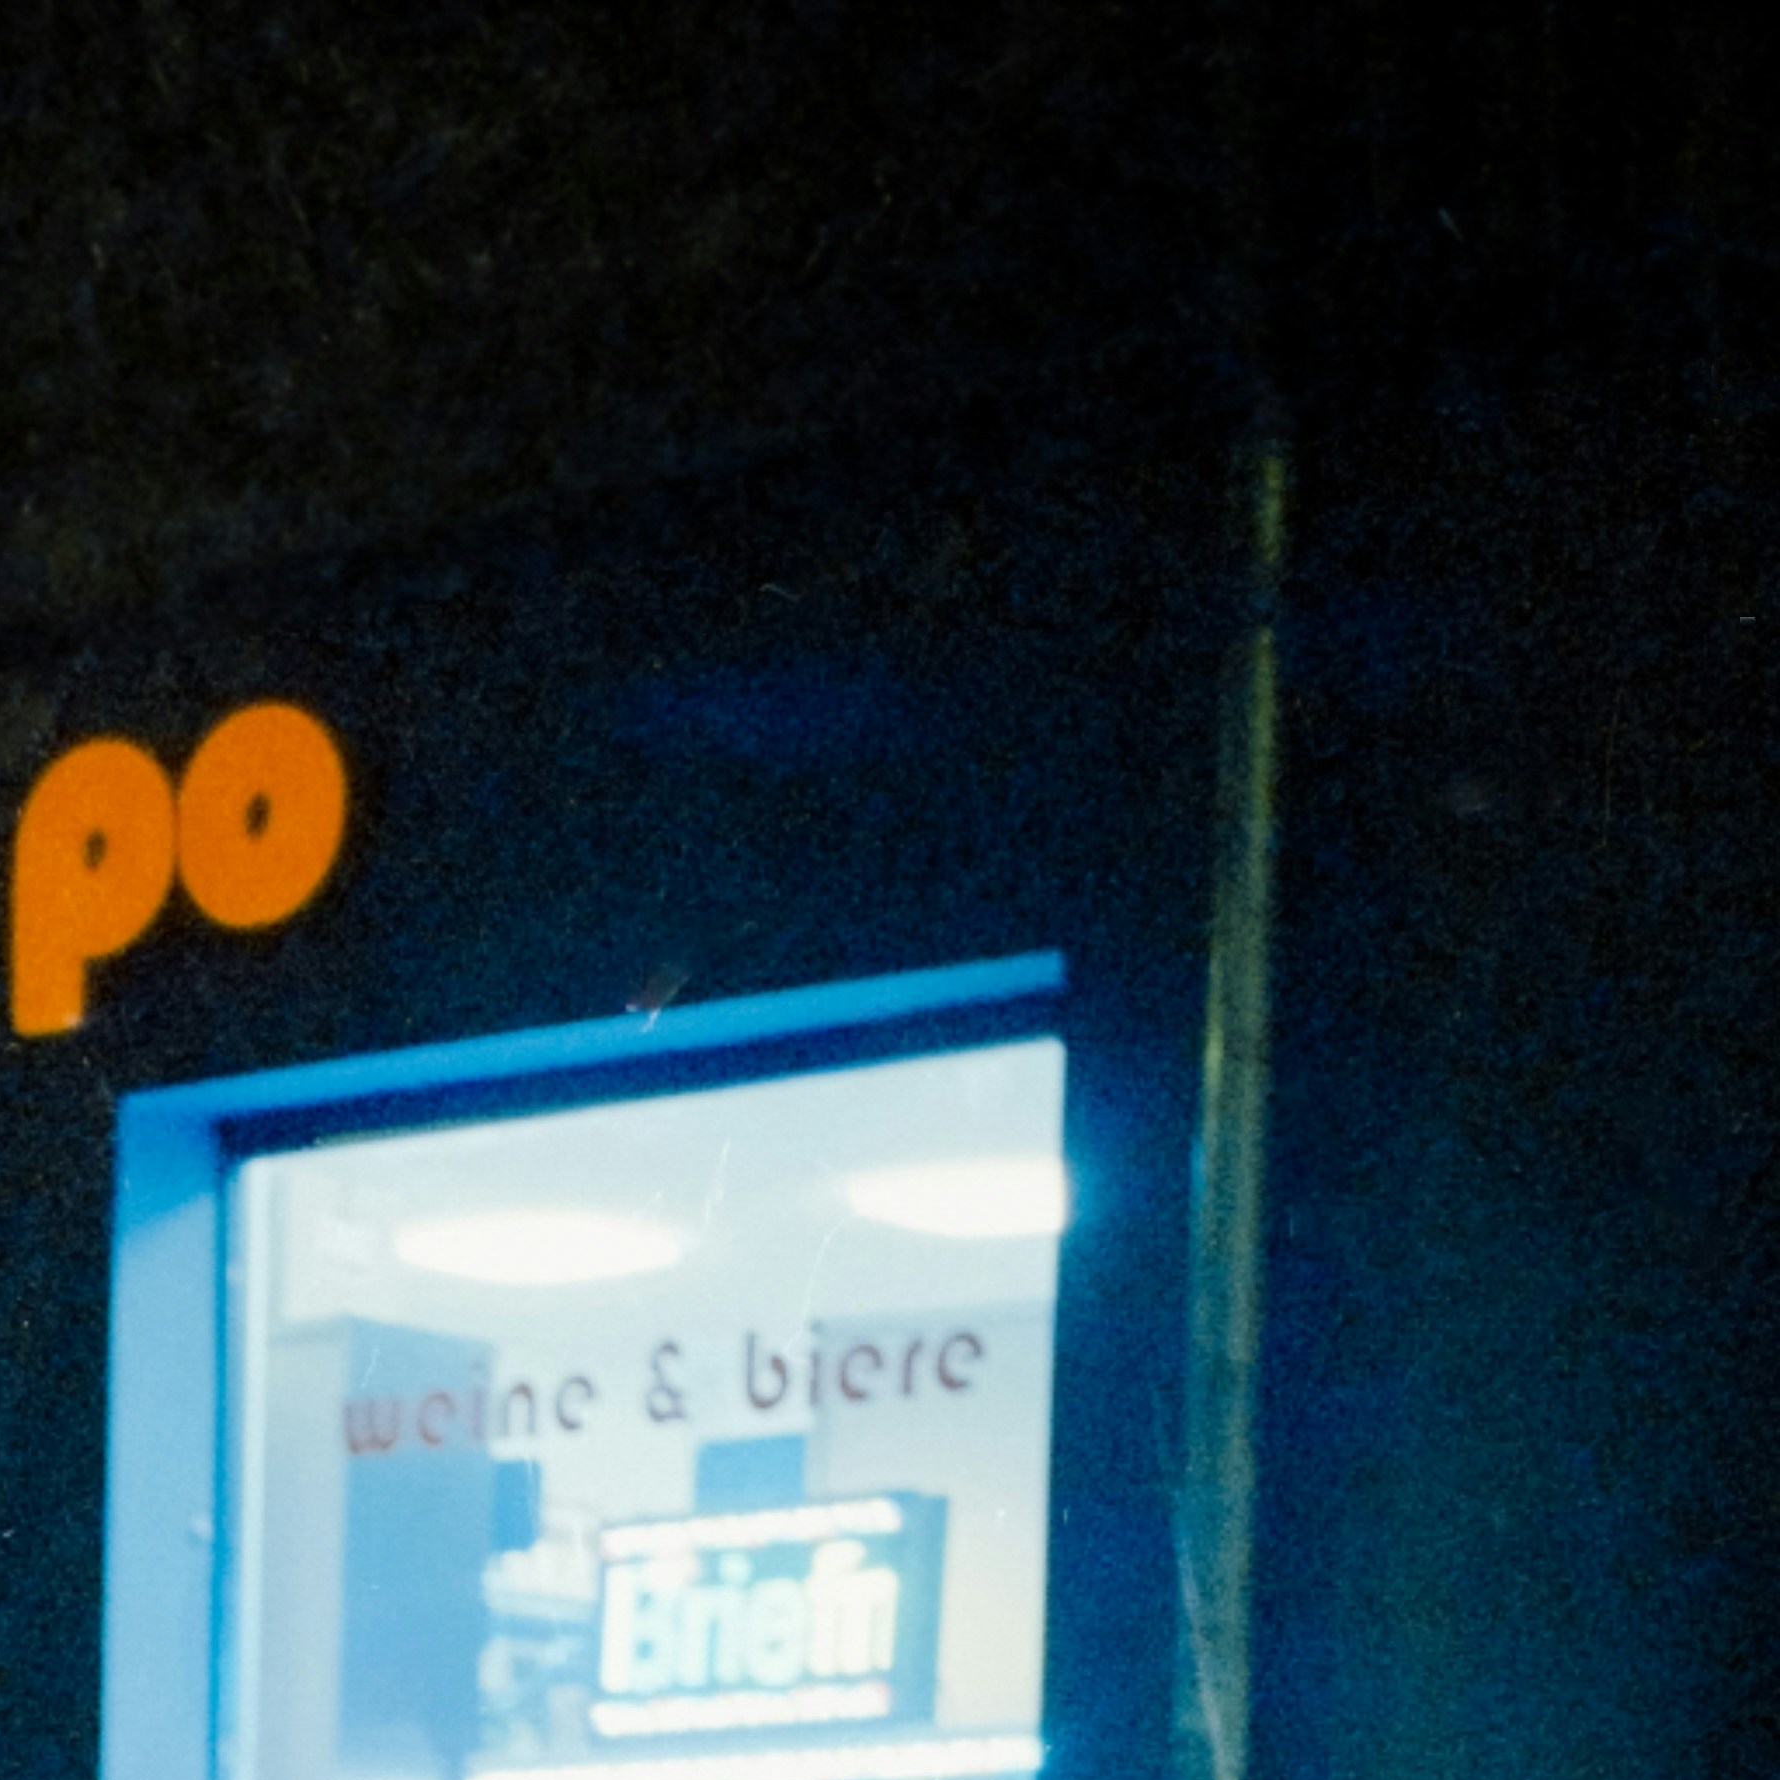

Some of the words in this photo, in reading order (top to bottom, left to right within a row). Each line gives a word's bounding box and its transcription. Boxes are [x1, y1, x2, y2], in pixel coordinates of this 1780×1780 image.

[11, 699, 348, 1039] po
[644, 1338, 691, 1425] &
[743, 1321, 988, 1411] biere
